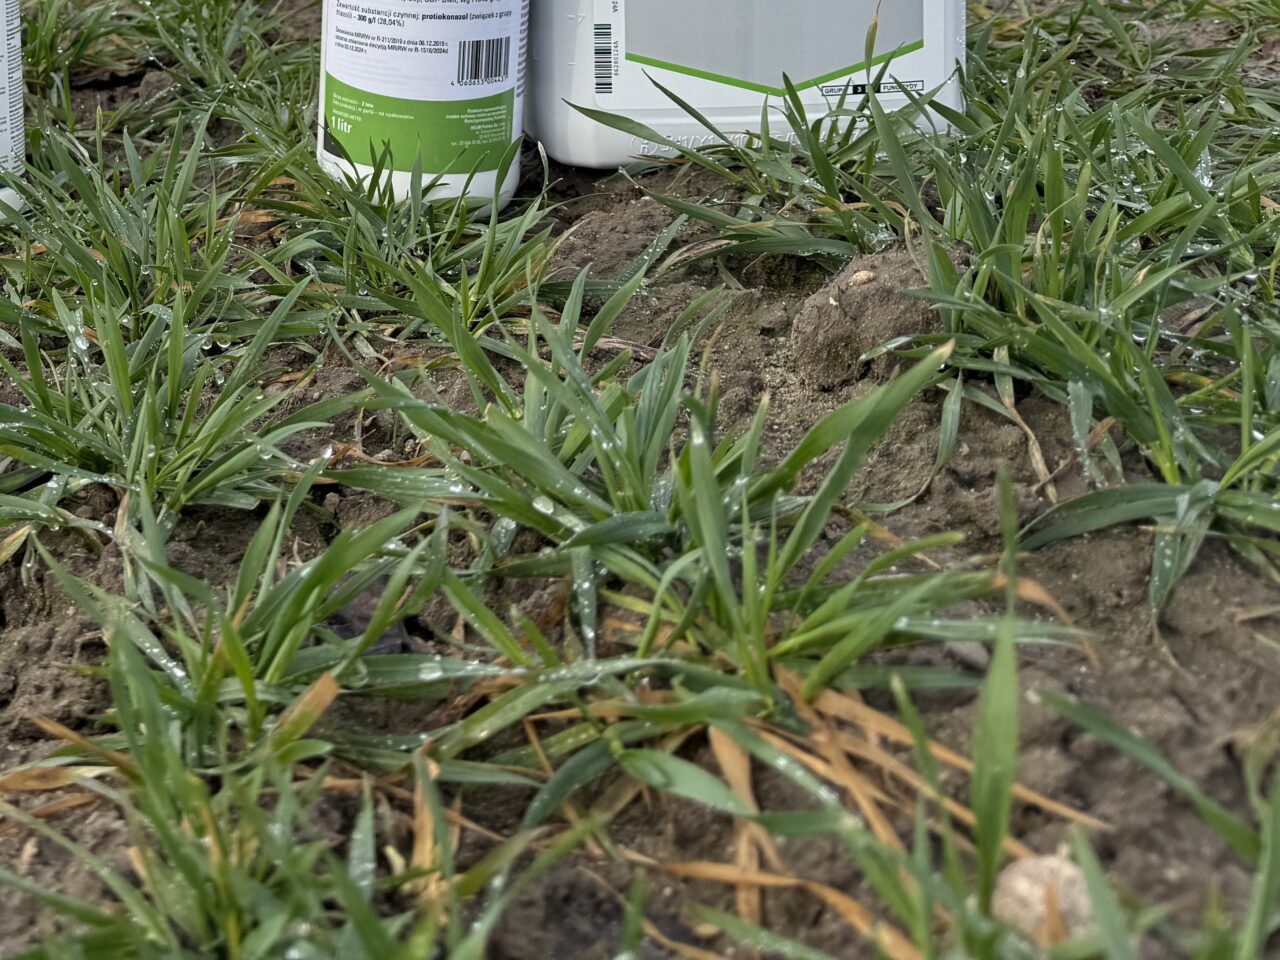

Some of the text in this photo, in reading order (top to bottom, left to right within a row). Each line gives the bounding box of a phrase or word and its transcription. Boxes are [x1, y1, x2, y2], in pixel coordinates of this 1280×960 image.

[361, 6, 392, 18] substancji
[421, 13, 469, 21] protiokonazol
[337, 117, 353, 134] litr
